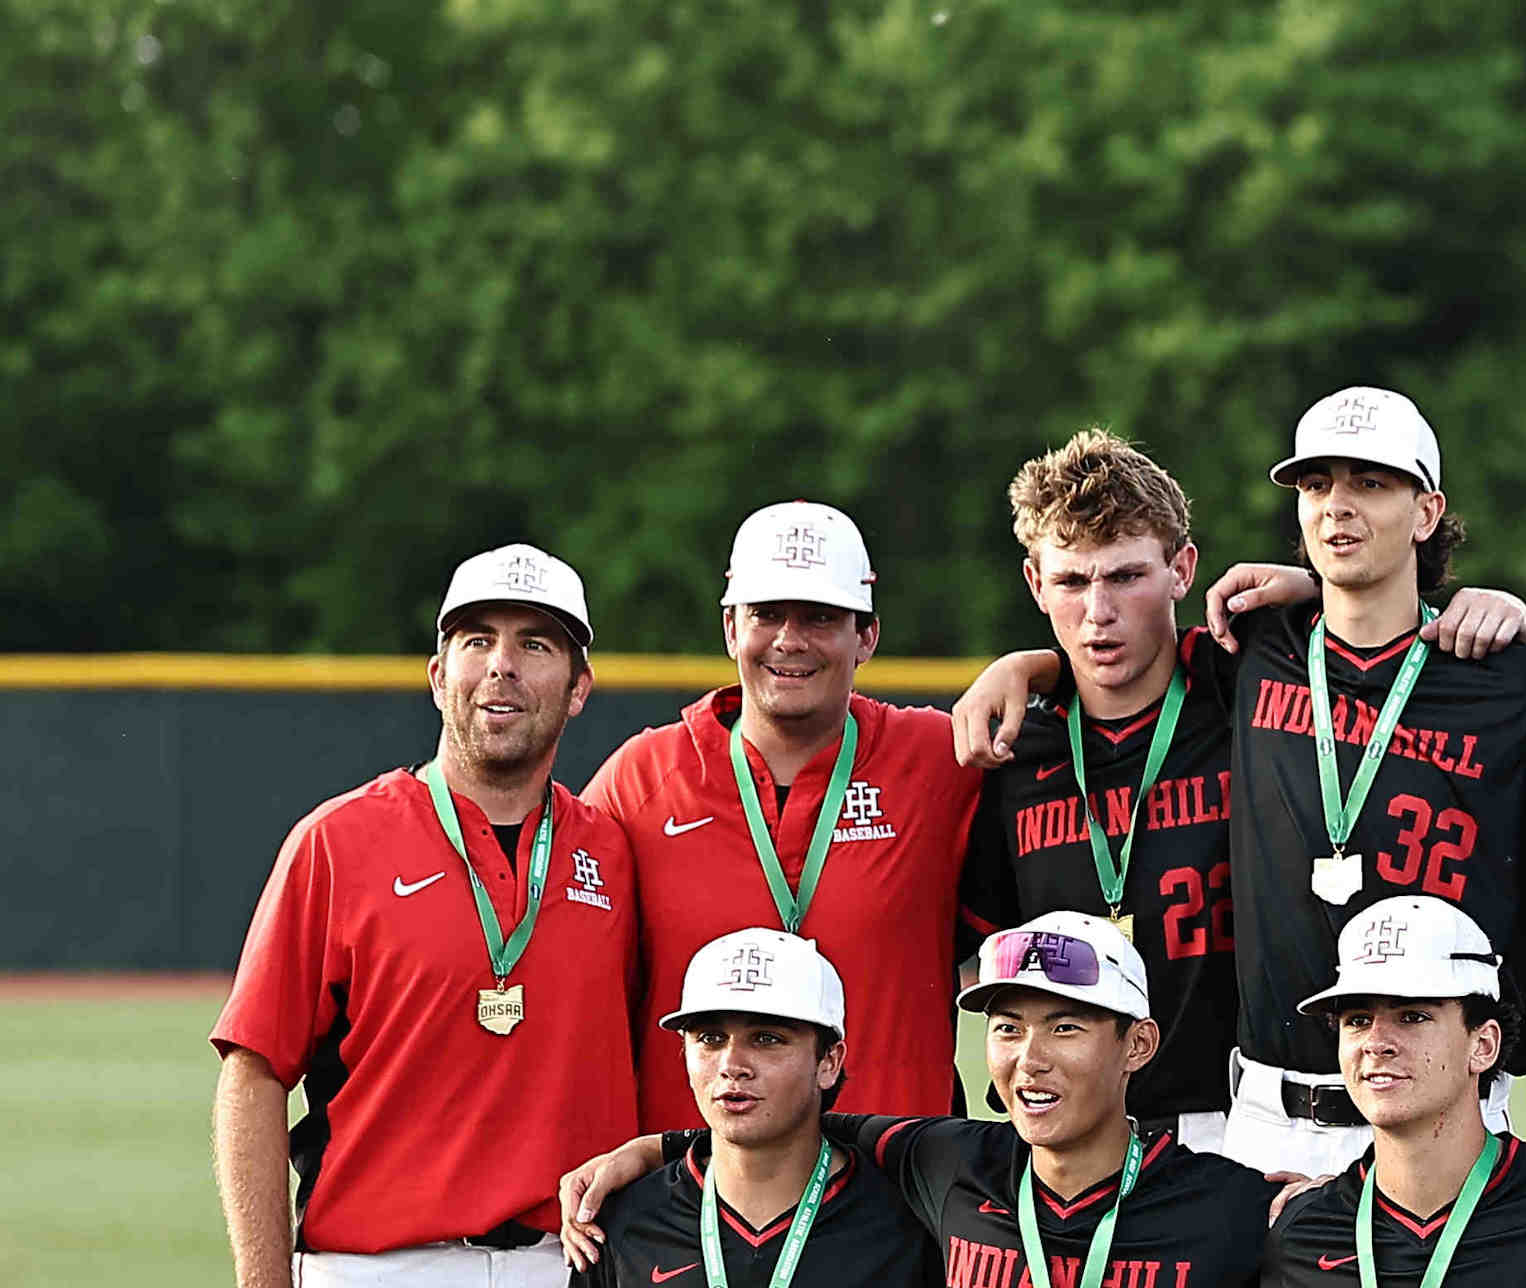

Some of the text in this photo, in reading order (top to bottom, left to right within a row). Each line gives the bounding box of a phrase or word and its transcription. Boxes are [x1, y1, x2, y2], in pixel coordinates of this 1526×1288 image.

[1250, 679, 1379, 746] INDAN
[833, 824, 896, 843] BASEBALL
[1377, 794, 1477, 901] 32
[480, 1004, 521, 1018] OHSAA
